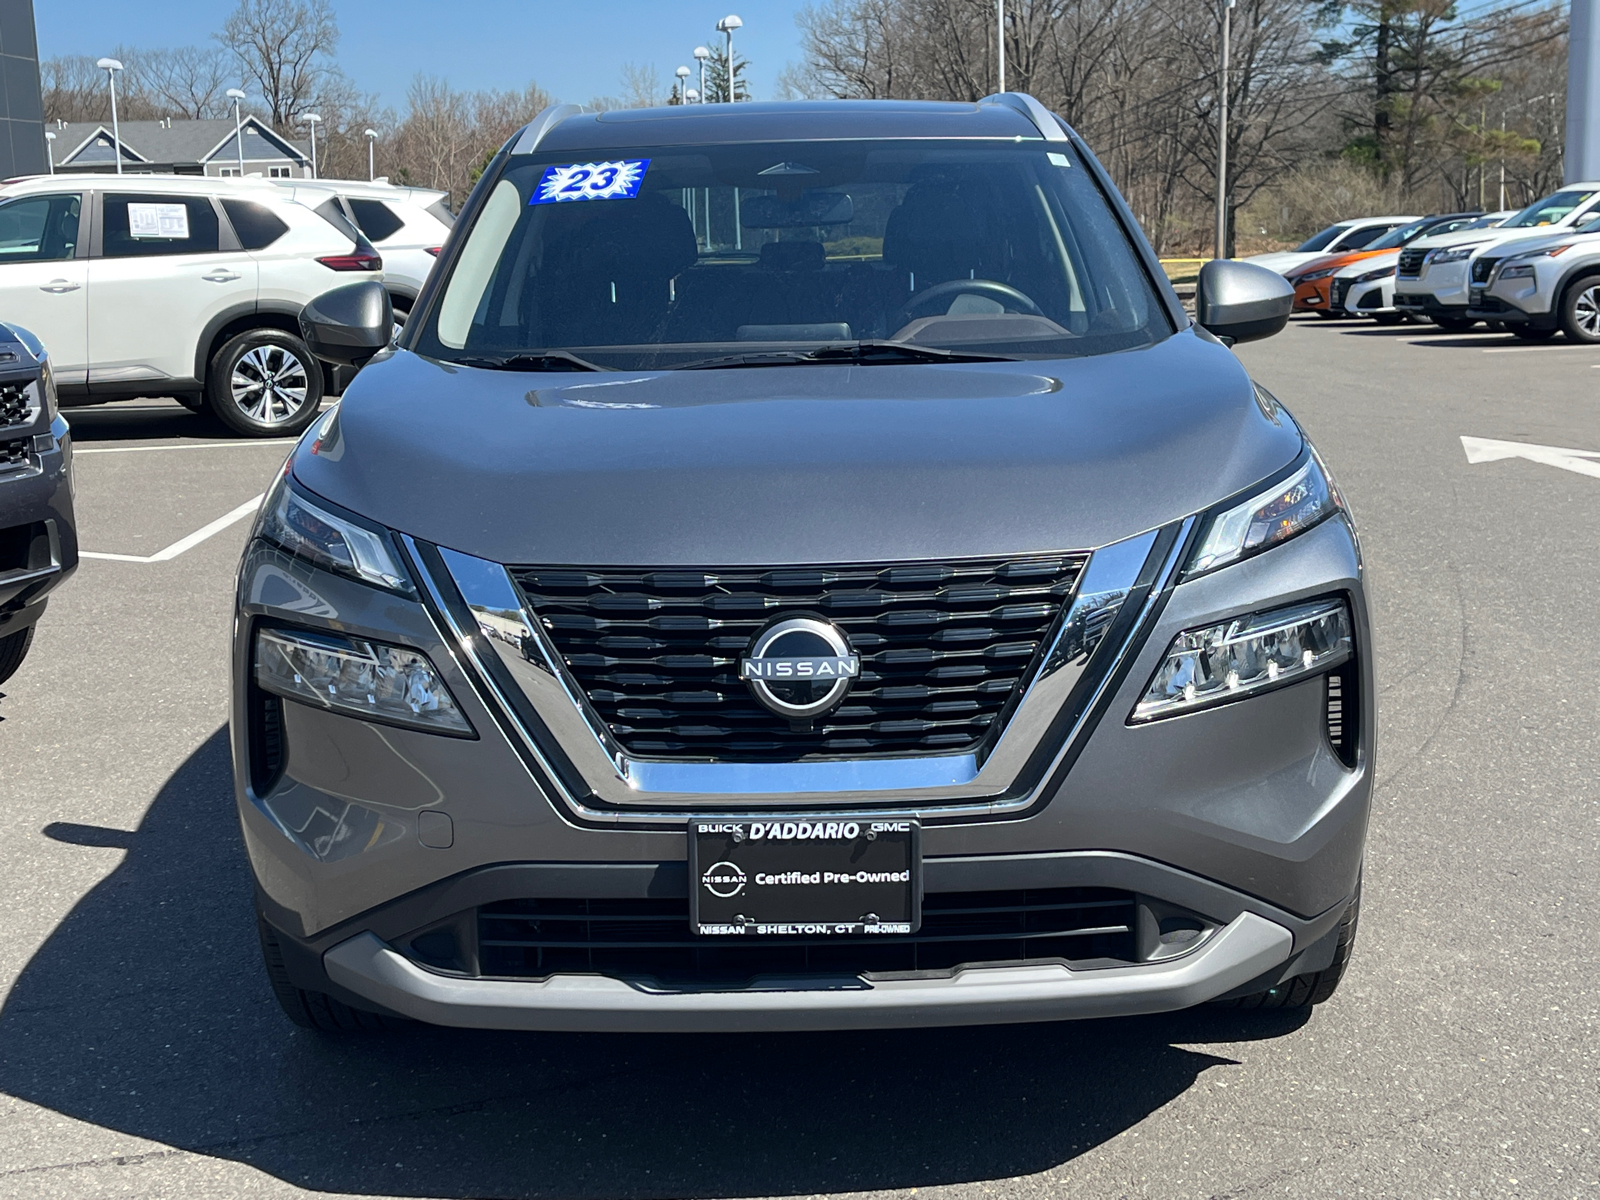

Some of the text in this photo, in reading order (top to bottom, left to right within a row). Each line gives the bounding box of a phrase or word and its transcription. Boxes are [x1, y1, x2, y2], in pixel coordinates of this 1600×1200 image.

[558, 167, 618, 193] 23
[745, 660, 855, 676] NISSAN
[698, 824, 743, 833] BUICK
[749, 822, 860, 839] D'ADDARIO
[871, 822, 910, 832] GMC
[702, 875, 747, 883] NISSAN
[755, 869, 910, 884] Certified Pre-Owned
[700, 925, 745, 934] NISSAN
[757, 924, 855, 934] SHELTON, CT
[864, 924, 910, 933] PRE-OWNED
